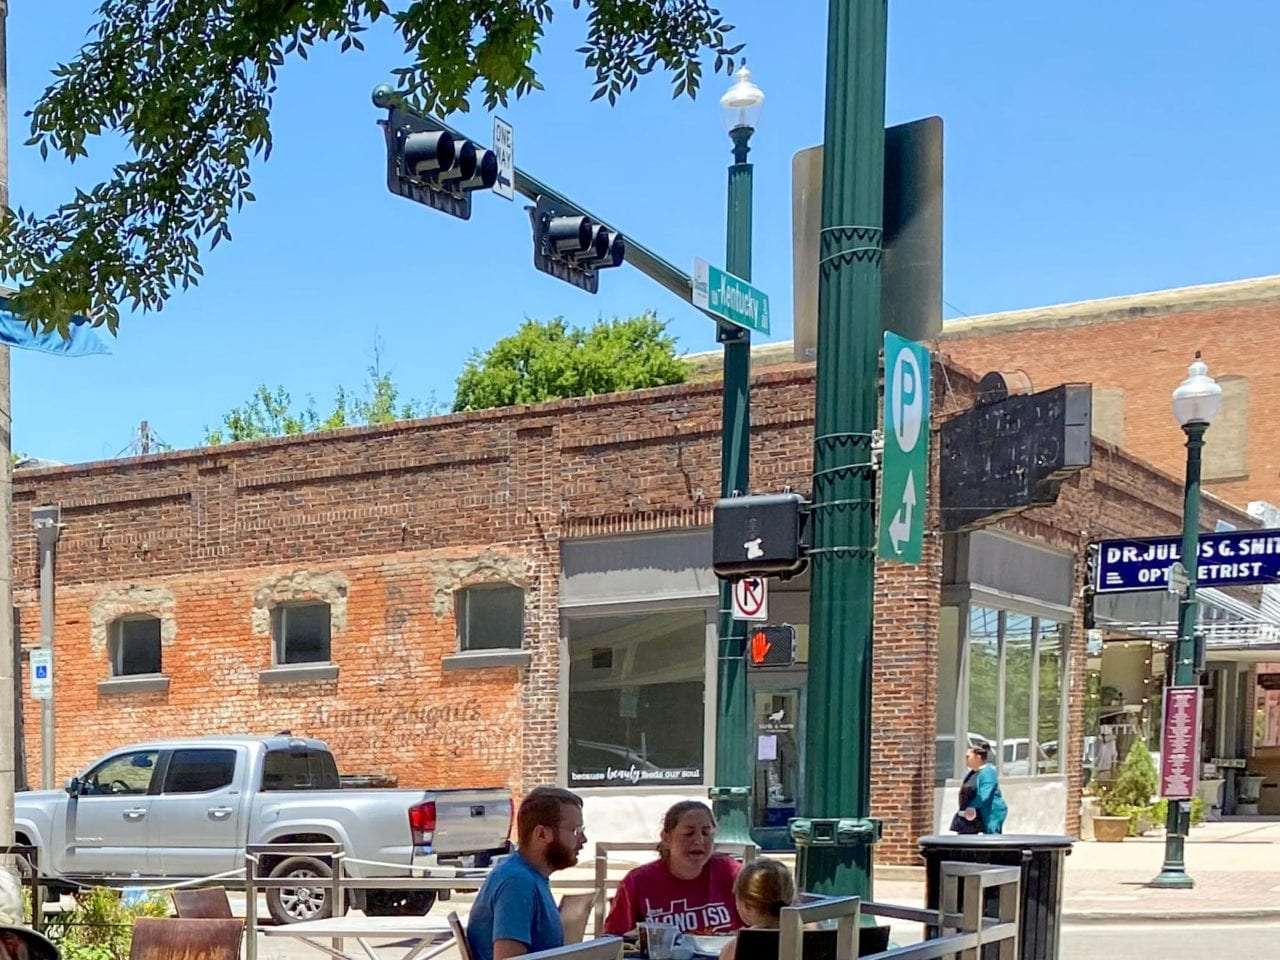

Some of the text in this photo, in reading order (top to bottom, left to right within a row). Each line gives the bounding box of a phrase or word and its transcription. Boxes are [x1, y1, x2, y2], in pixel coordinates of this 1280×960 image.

[496, 124, 511, 149] ONE
[720, 273, 759, 328] Kentucky
[900, 359, 916, 438] P
[1218, 540, 1235, 557] G.
[1138, 562, 1263, 583] OPTETRIST
[606, 764, 640, 784] beauty
[664, 770, 680, 779] our
[645, 905, 731, 932] PANO ISD
